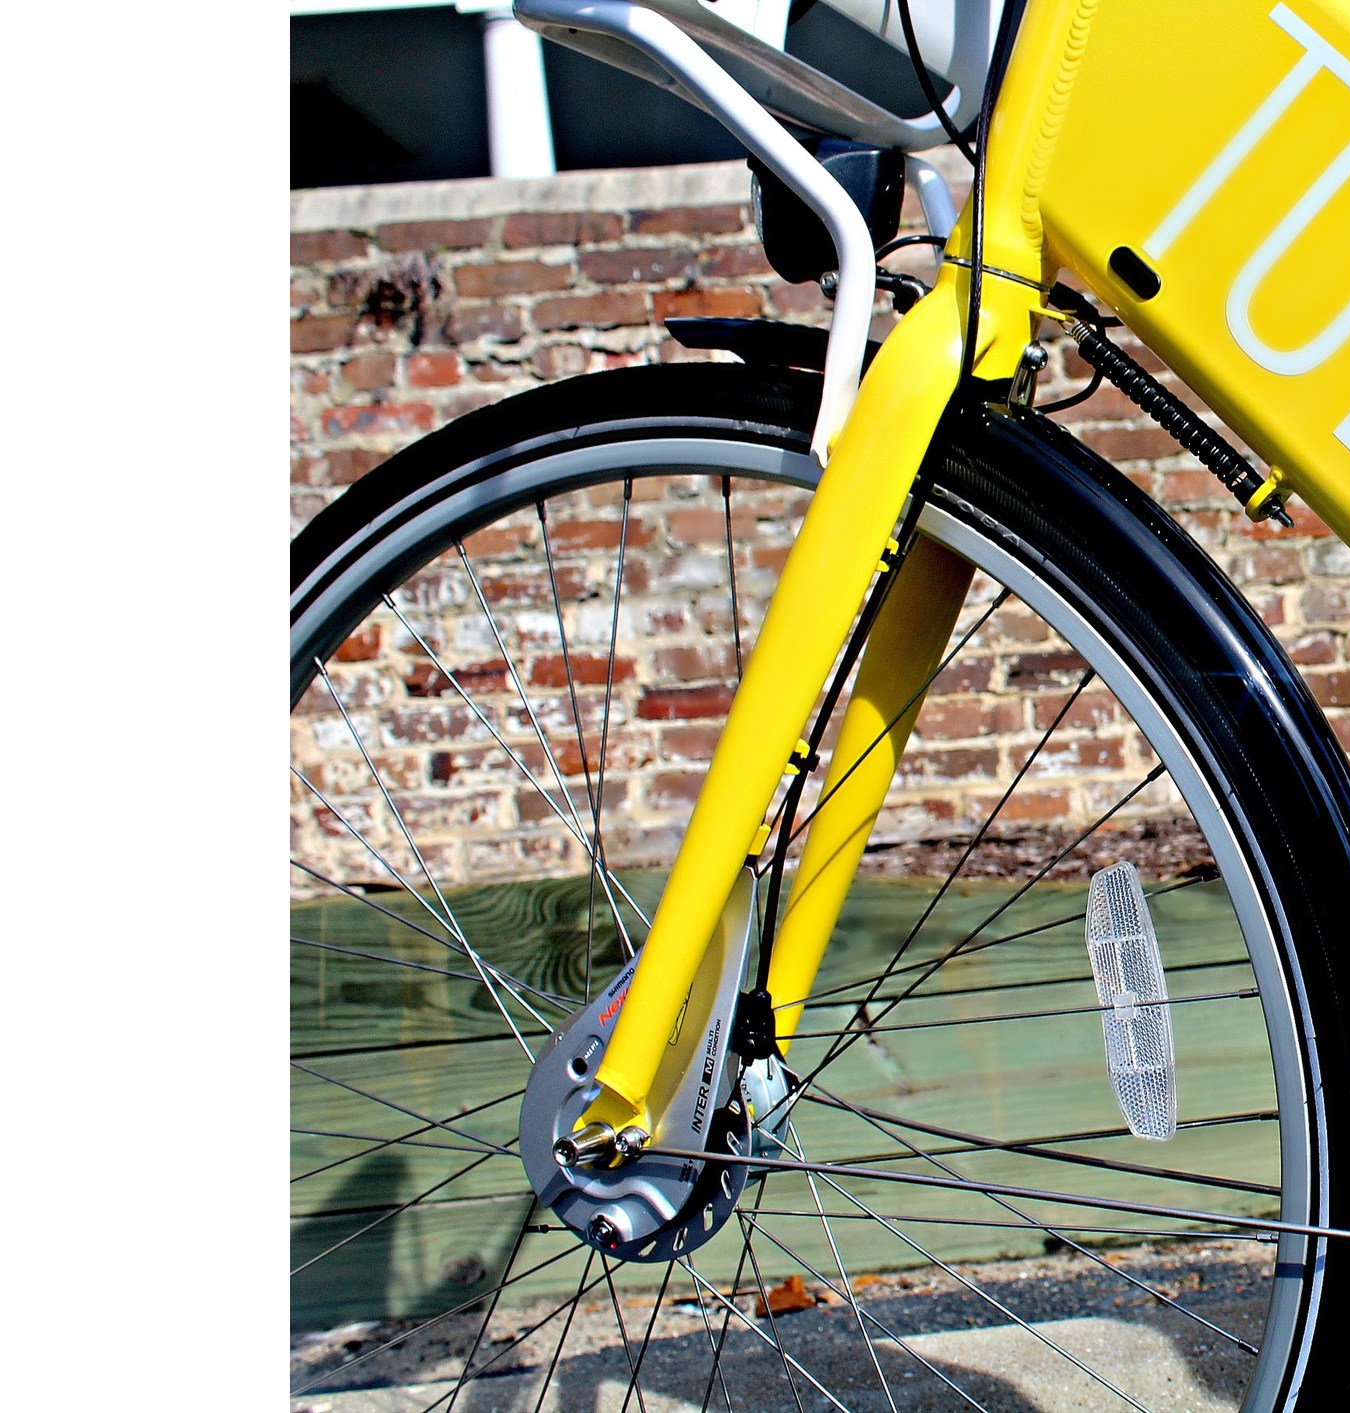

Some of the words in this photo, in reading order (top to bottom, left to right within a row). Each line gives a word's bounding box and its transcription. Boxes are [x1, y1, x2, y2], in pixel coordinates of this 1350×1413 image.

[608, 967, 635, 998] SHIMANO
[599, 988, 629, 1027] Nex
[706, 1030, 715, 1055] MULTI
[712, 1019, 721, 1056] CONDITION
[691, 1086, 710, 1134] INTER
